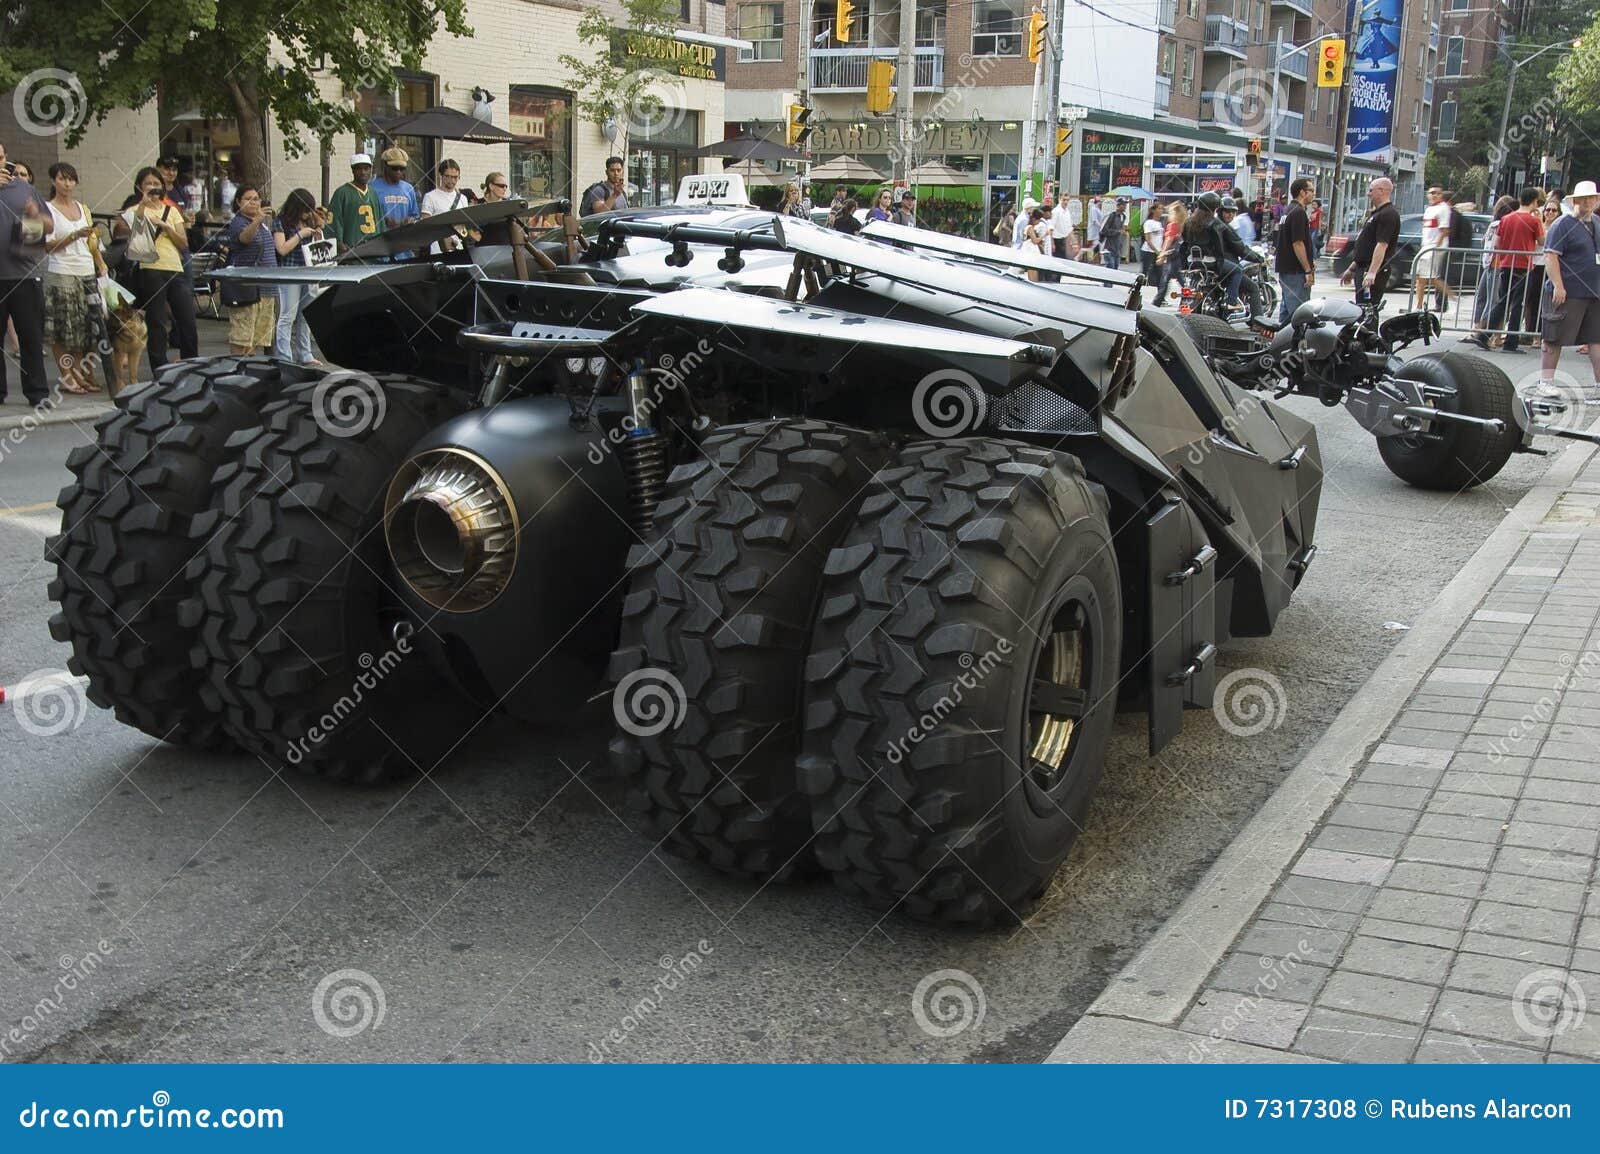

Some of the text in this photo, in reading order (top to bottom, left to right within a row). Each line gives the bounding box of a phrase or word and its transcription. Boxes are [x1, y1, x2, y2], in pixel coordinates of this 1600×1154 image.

[1360, 75, 1386, 93] SOLVE
[1351, 87, 1388, 102] ROBLEM
[1354, 97, 1391, 113] MARIA?
[1085, 143, 1142, 152] SANDWICHES
[688, 180, 729, 198] TAXI
[358, 205, 376, 234] 3
